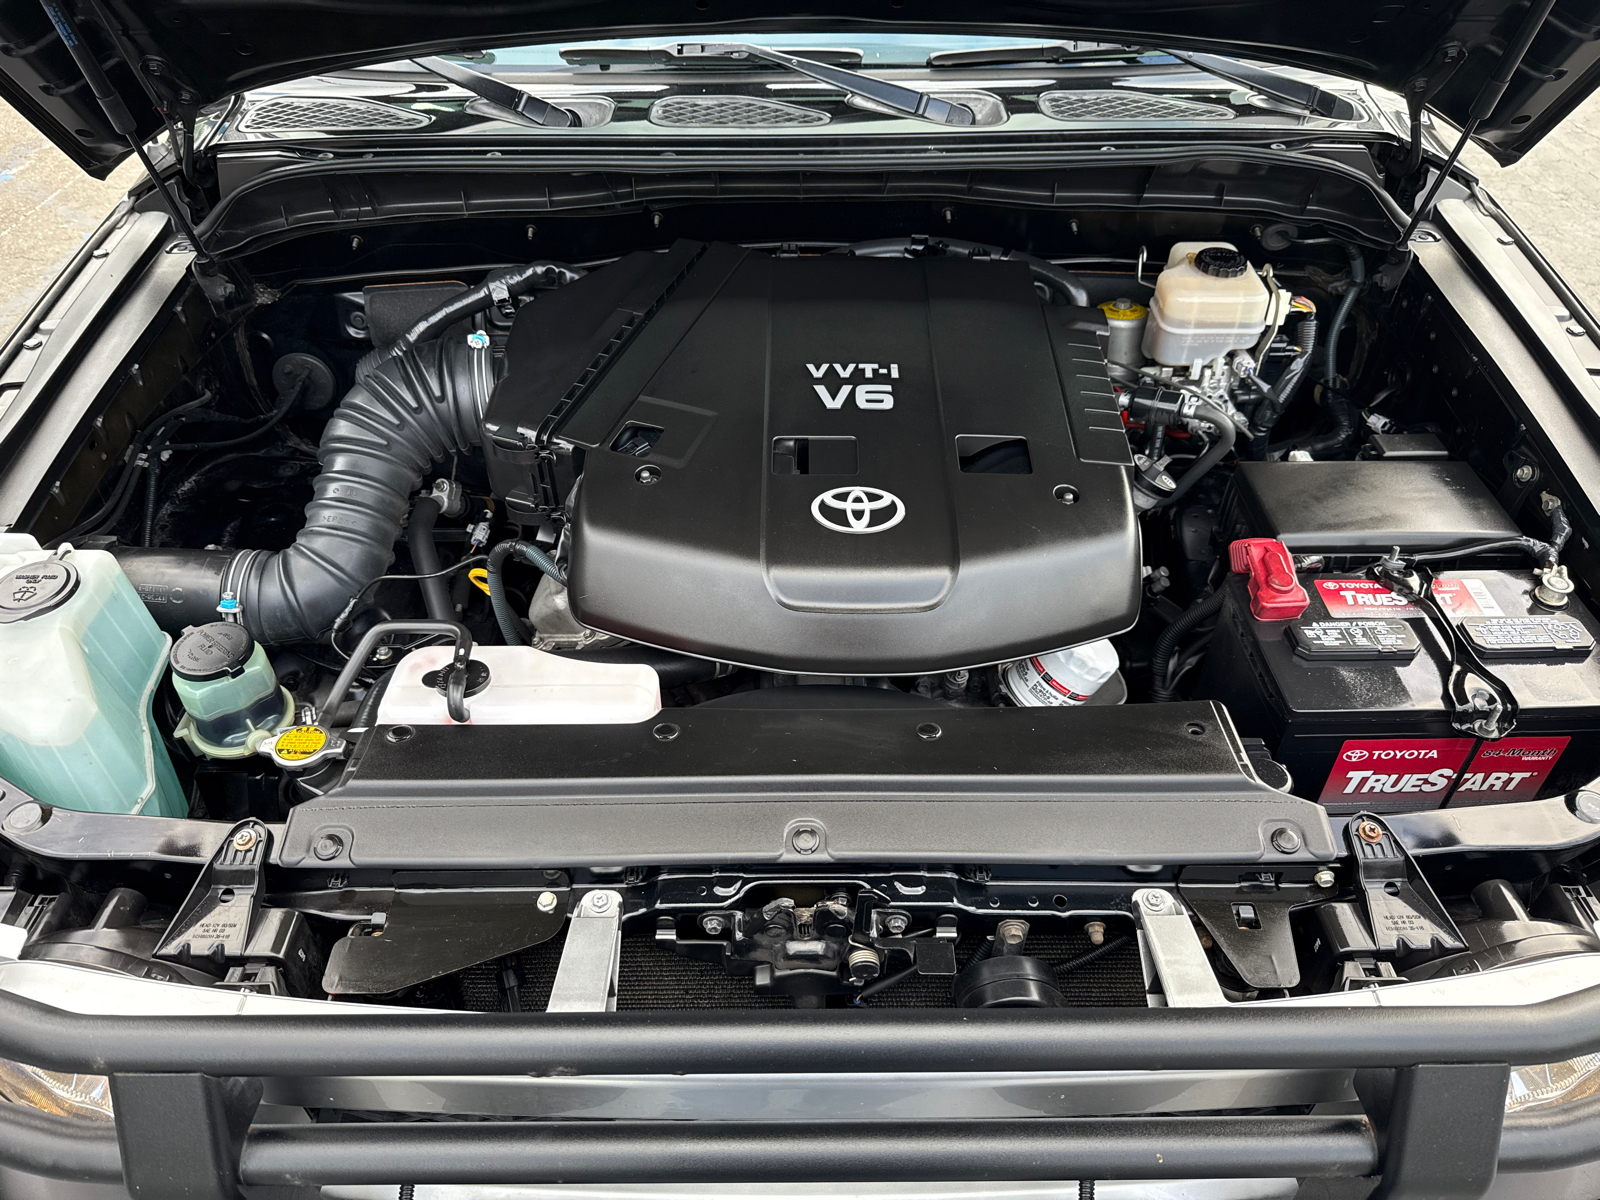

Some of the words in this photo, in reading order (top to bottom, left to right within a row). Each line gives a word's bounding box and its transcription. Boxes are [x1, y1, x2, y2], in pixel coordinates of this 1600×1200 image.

[812, 384, 894, 410] V6
[197, 629, 215, 644] POWER
[212, 640, 235, 660] STEERING
[198, 643, 214, 656] FLUID
[1371, 749, 1438, 760] TOYOTA
[1481, 747, 1559, 758] 84-Month
